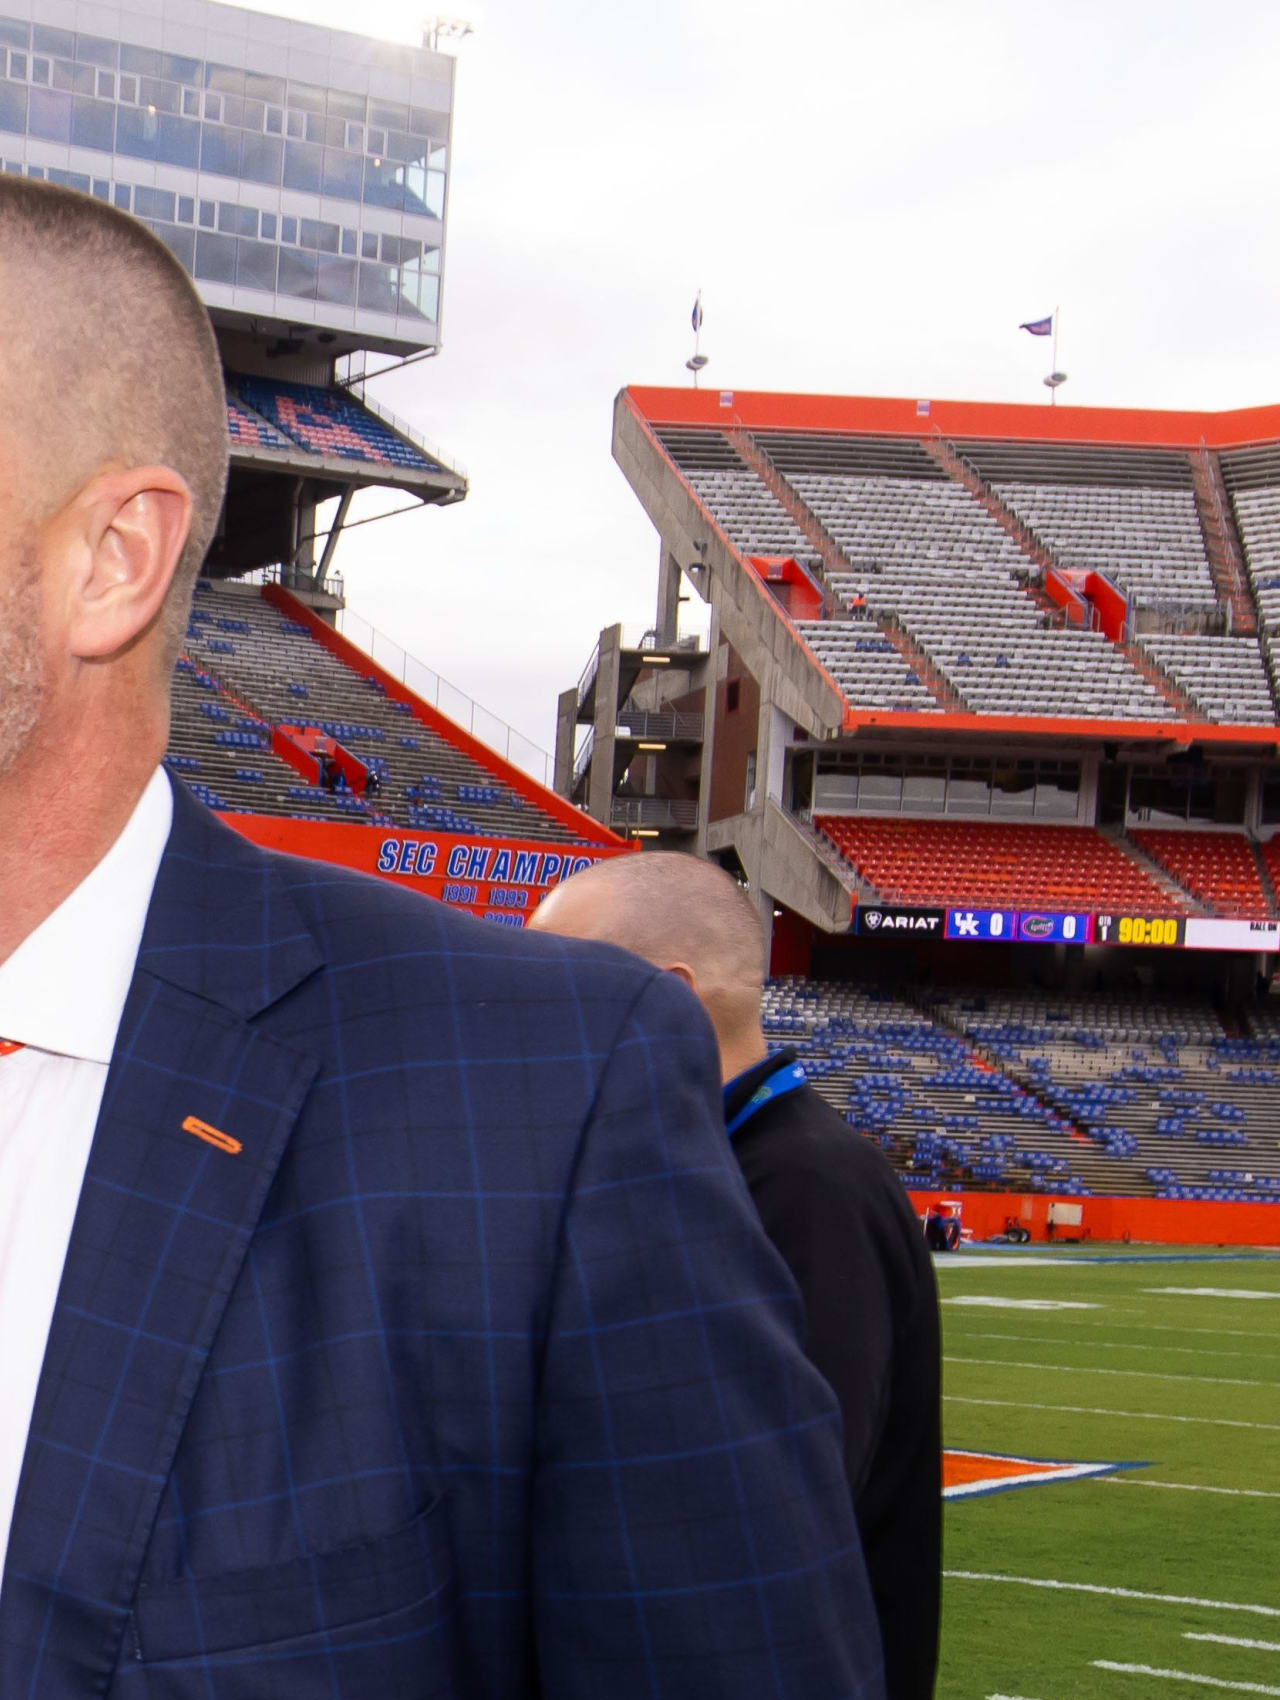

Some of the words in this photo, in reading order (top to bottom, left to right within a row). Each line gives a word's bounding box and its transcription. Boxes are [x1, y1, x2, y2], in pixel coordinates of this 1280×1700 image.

[377, 839, 438, 876] SEC
[447, 845, 602, 886] CHAMPI
[490, 887, 529, 908] 1993
[881, 916, 939, 930] ARIAT
[990, 912, 1003, 936] 0
[1062, 915, 1076, 939] 0
[1101, 926, 1108, 941] 1
[1118, 917, 1178, 945] 90:00
